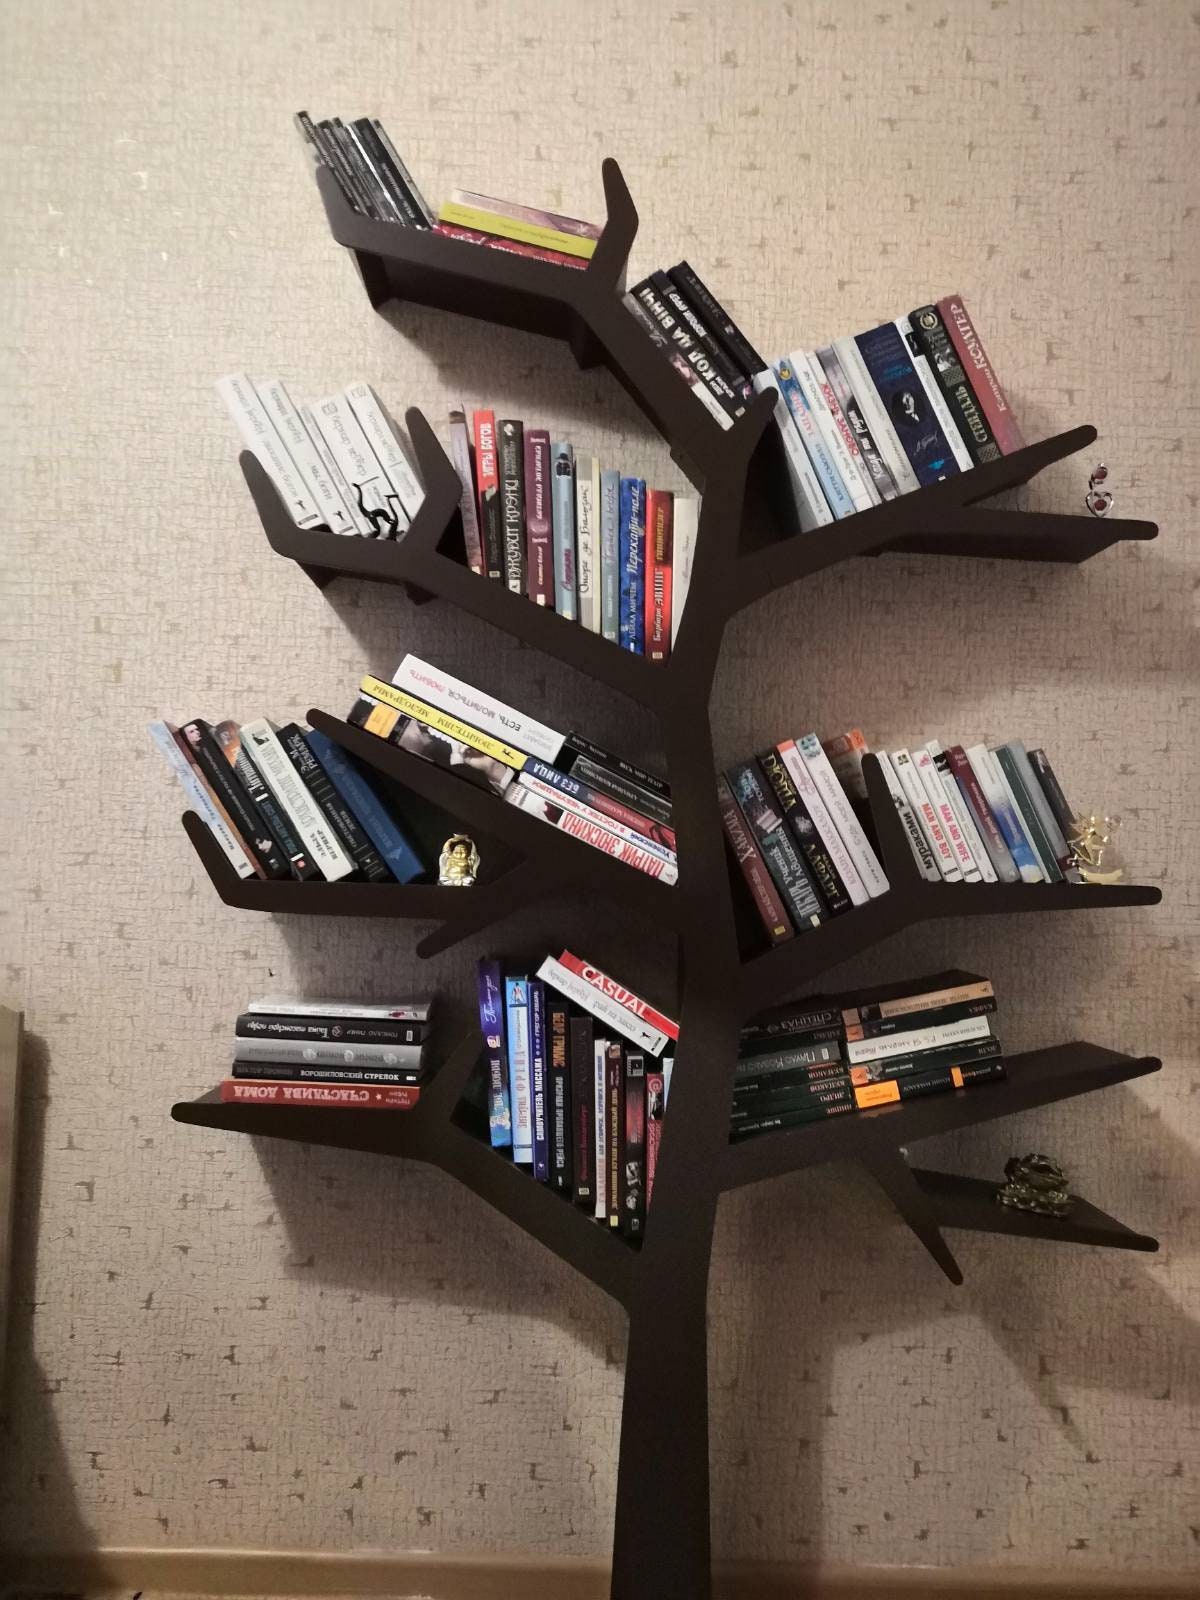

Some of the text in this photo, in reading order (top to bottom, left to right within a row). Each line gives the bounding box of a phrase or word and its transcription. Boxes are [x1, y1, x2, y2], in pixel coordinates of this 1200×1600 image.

[638, 285, 676, 329] ВІНЧІ
[669, 324, 695, 351] ДА
[949, 300, 988, 371] КОУЛТЕР
[687, 347, 719, 382] КОД
[819, 380, 842, 416] ЖИЗНЬ
[835, 415, 860, 458] ЗАНОВО
[846, 407, 868, 436] рядом
[951, 383, 991, 445] СТЕНДАЛЬ
[478, 422, 494, 477] ИГРЫ БОГОВ
[864, 451, 888, 480] Когда
[504, 479, 520, 523] КРЭНЦ
[506, 525, 522, 579] ДЖУДИТ
[577, 484, 592, 594] Оноре де Бальзак
[625, 485, 642, 640] ЛЕЙЛА МИЧЕМ Перекати-поле
[652, 568, 664, 642] Барбара ЭВИНГ
[371, 682, 431, 719] МЕЛОДРАМЫ
[407, 666, 523, 734] ЕСТЬ, МОЛИТЬСЯ, ЛЮБИТЬ
[290, 731, 319, 771] РЕМАРК
[436, 715, 494, 751] ЛЮБИТЕЛЯМ
[532, 761, 581, 794] БЕЗ ЛИЦА
[532, 777, 581, 811] ЧЕБУРАШКИ
[758, 752, 799, 812] ДЮМА
[559, 812, 620, 857] ЗЮСКИНД
[901, 808, 937, 870] мураками
[919, 801, 953, 861] MAN AND BOY
[938, 802, 970, 863] MAN AND WIFE
[617, 842, 667, 879] ПАТРИК
[767, 845, 794, 885] Ученик
[771, 824, 806, 880] Авиценны
[801, 839, 840, 900] ЛАФАРГ
[785, 876, 823, 920] ЛЕКАРЬ
[579, 962, 651, 1020] CASUAL
[246, 1019, 330, 1038] Тайна масонской ложи
[552, 1012, 564, 1033] БЕАР
[779, 1007, 833, 1033] СПЕЦНАЗ
[299, 1068, 399, 1081] ВОРОШИЛОВСКИЙ СТРЕЛОК
[489, 1058, 502, 1089] ЛЮБВИ
[512, 1049, 527, 1092] ФРЕЙД
[533, 1057, 543, 1092] МАССАЖА
[784, 1049, 816, 1067] ПАУЛО
[232, 1084, 370, 1103] СЧАСТЛИВА ДОМА
[554, 1076, 563, 1106] ПРИЗРАКИ
[610, 1087, 618, 1105] ДЕНЬ
[534, 1092, 544, 1141] САМОУЧИТЕЛЬ
[555, 1108, 563, 1146] ПРОПАВШЕГО
[609, 1106, 618, 1136] КАЖДЫЙ
[555, 1148, 564, 1168] РЕЙСА
[610, 1147, 618, 1169] КУХНЯ
[610, 1170, 618, 1208] ДОМАШНЯЯ
